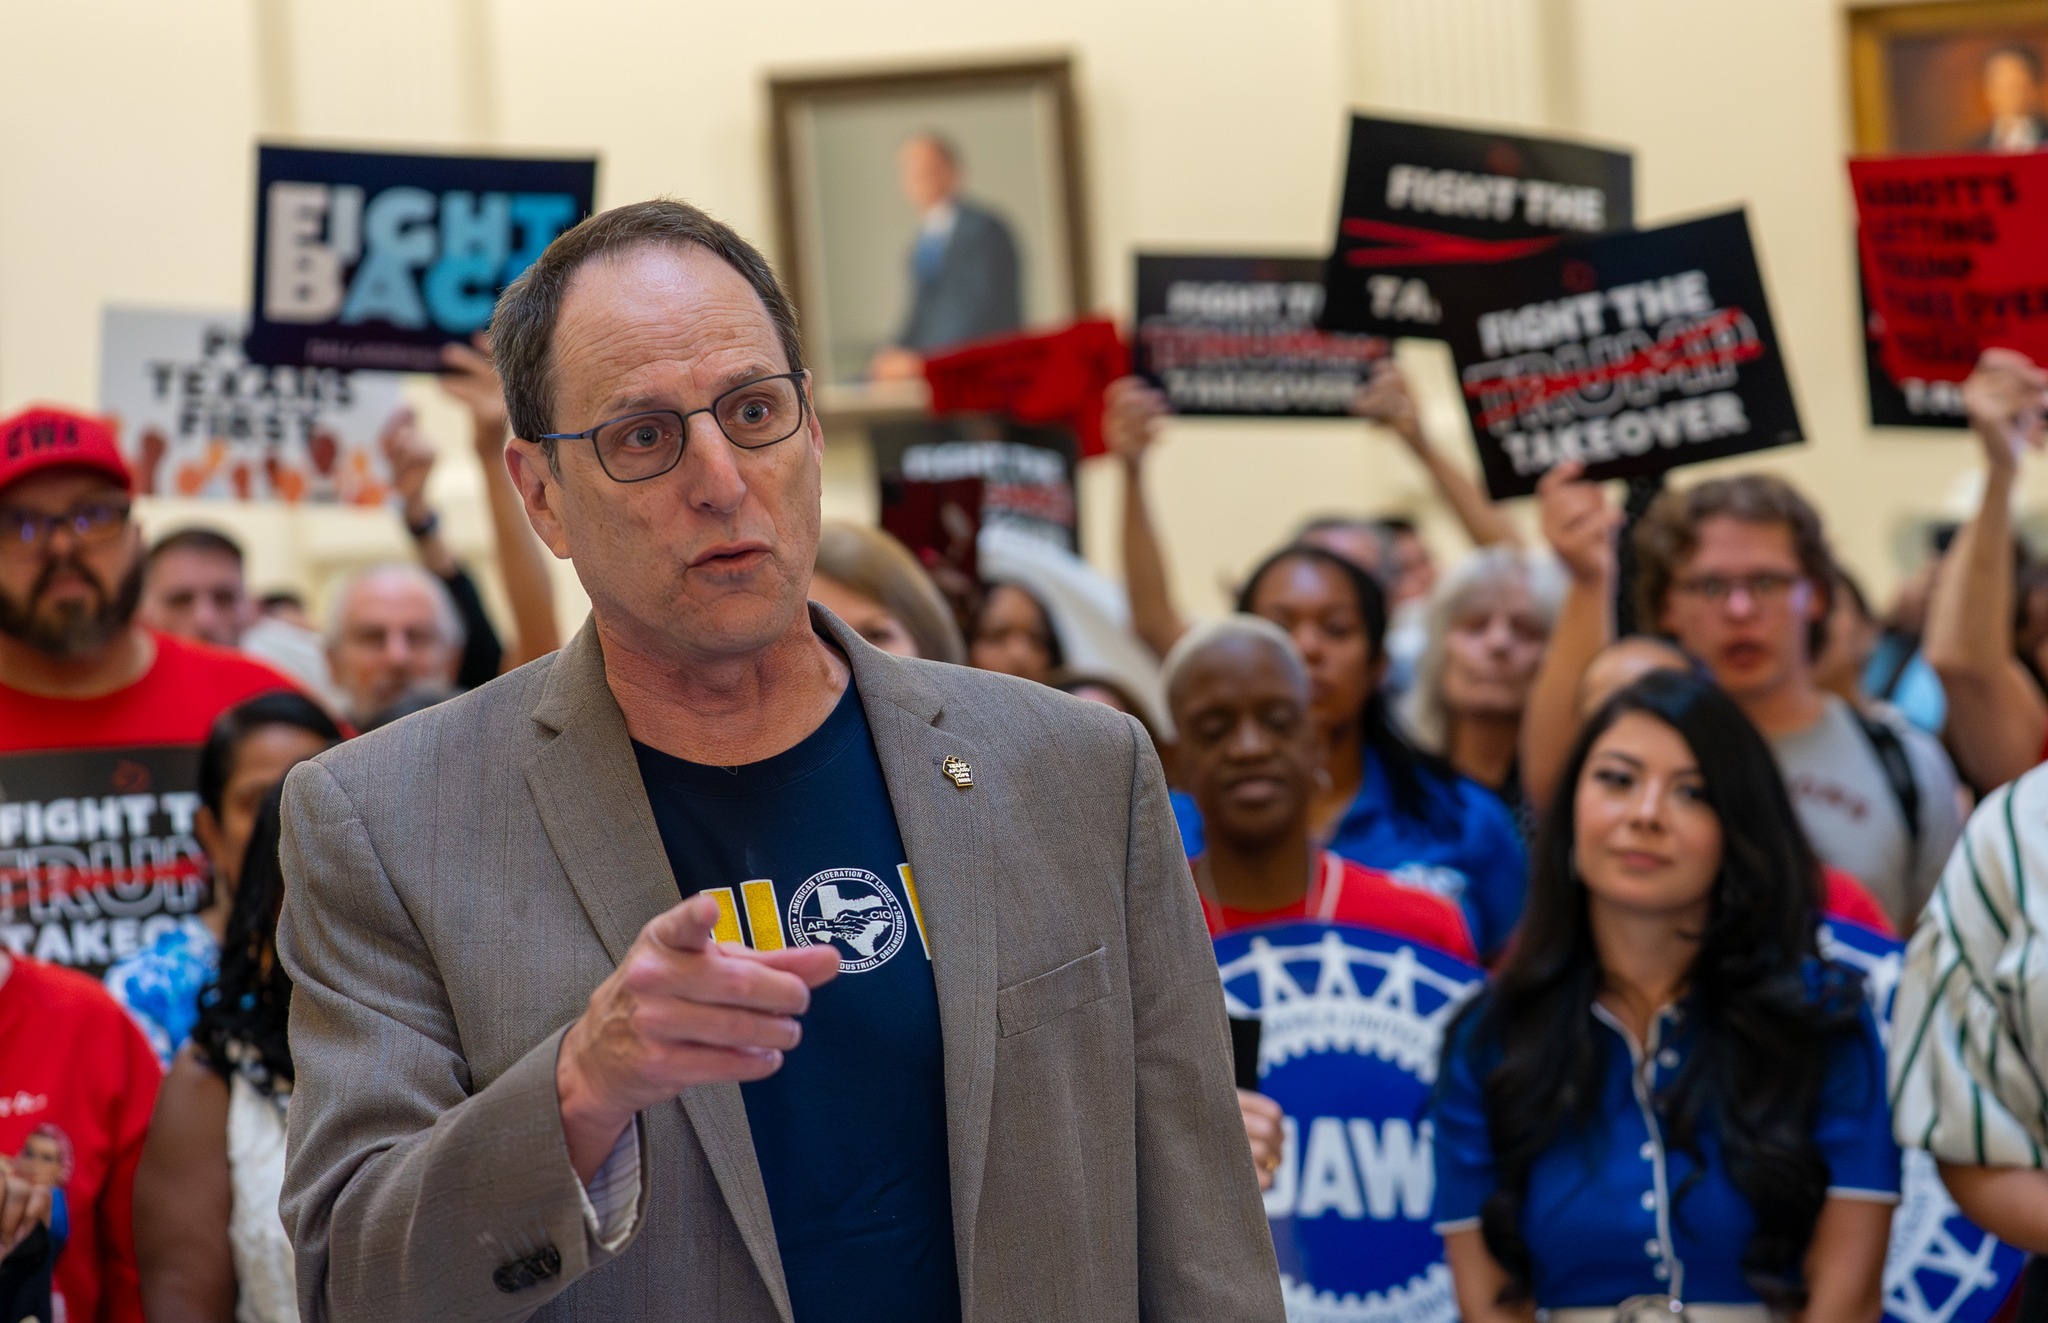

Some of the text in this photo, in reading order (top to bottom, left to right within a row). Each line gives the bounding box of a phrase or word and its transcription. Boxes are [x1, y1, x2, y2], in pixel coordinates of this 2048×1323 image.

[267, 181, 577, 264] FIGHT
[1386, 164, 1605, 232] FIGHT THE
[264, 245, 510, 333] BAC
[1367, 275, 1443, 325] TA
[1477, 269, 1713, 357] FIGHT THE
[150, 361, 354, 406] TEXANS
[181, 404, 316, 441] FIRST
[1502, 390, 1751, 477] TAKEOVER
[0, 794, 158, 847] FIGHT
[792, 870, 895, 914] AMERICAN FEDERATION OF LABOR
[807, 910, 892, 931] AFL CIO
[839, 957, 880, 971] DUSTRIAL
[879, 910, 904, 960] ORGANIZATIONS
